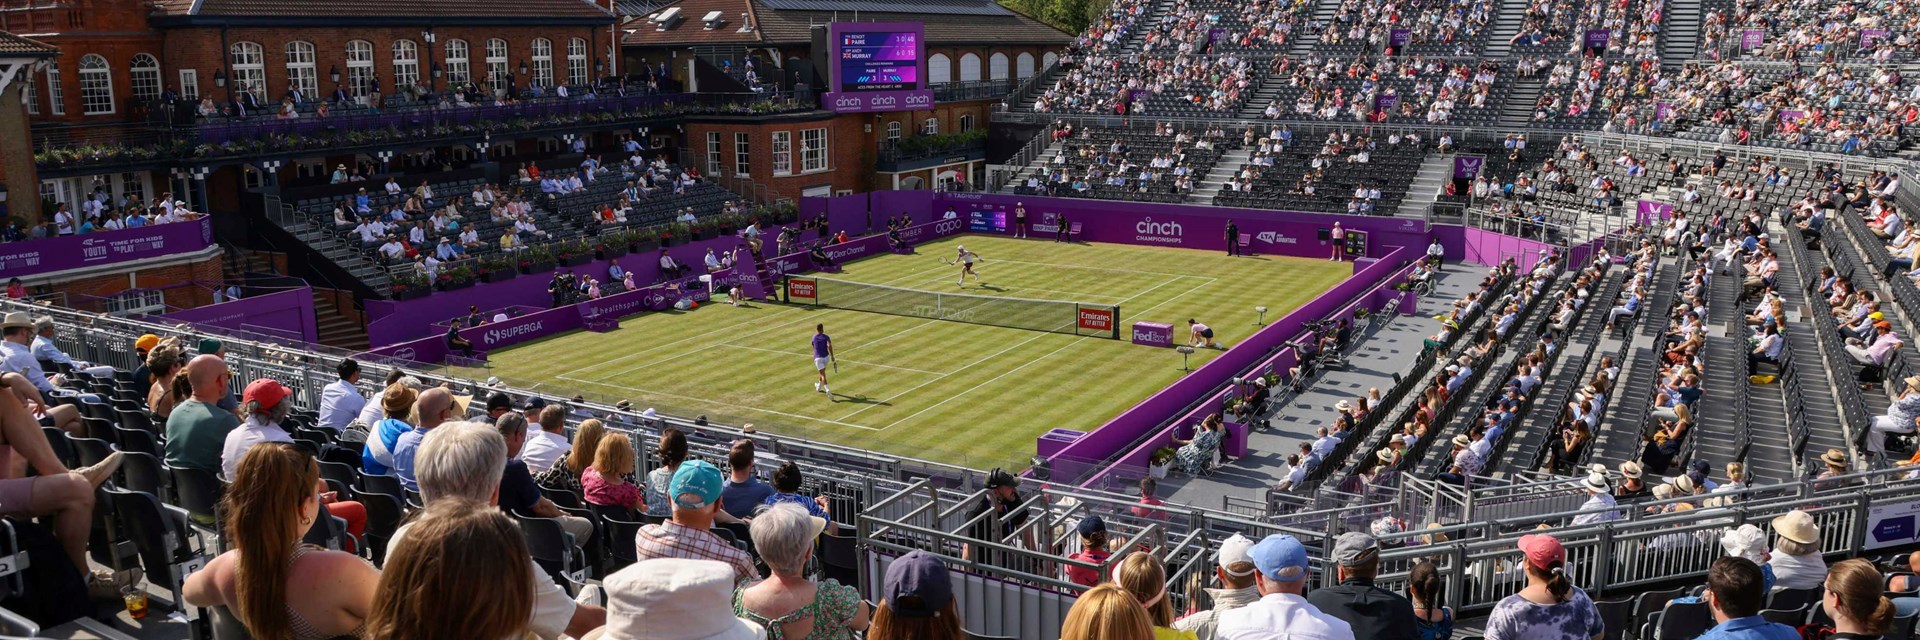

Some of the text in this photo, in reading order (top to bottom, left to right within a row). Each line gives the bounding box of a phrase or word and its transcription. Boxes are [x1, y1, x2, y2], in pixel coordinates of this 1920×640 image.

[836, 95, 861, 107] cinch
[871, 94, 896, 105] cinch
[906, 92, 930, 104] cinch
[935, 219, 962, 235] oppo
[1136, 216, 1182, 236] cinch
[1136, 235, 1182, 244] CHAMPIONSHIPS
[83, 246, 107, 258] YOUTH
[120, 244, 134, 254] PLAY
[152, 240, 164, 249] WAY
[834, 244, 866, 259] Clear Channel
[26, 257, 40, 266] WAY
[739, 272, 757, 282] cinch
[601, 300, 639, 315] healthspan
[1081, 312, 1110, 321] Emirates
[501, 322, 542, 339] SUPERGA
[1134, 330, 1165, 344] FedEx
[189, 564, 199, 573] P
